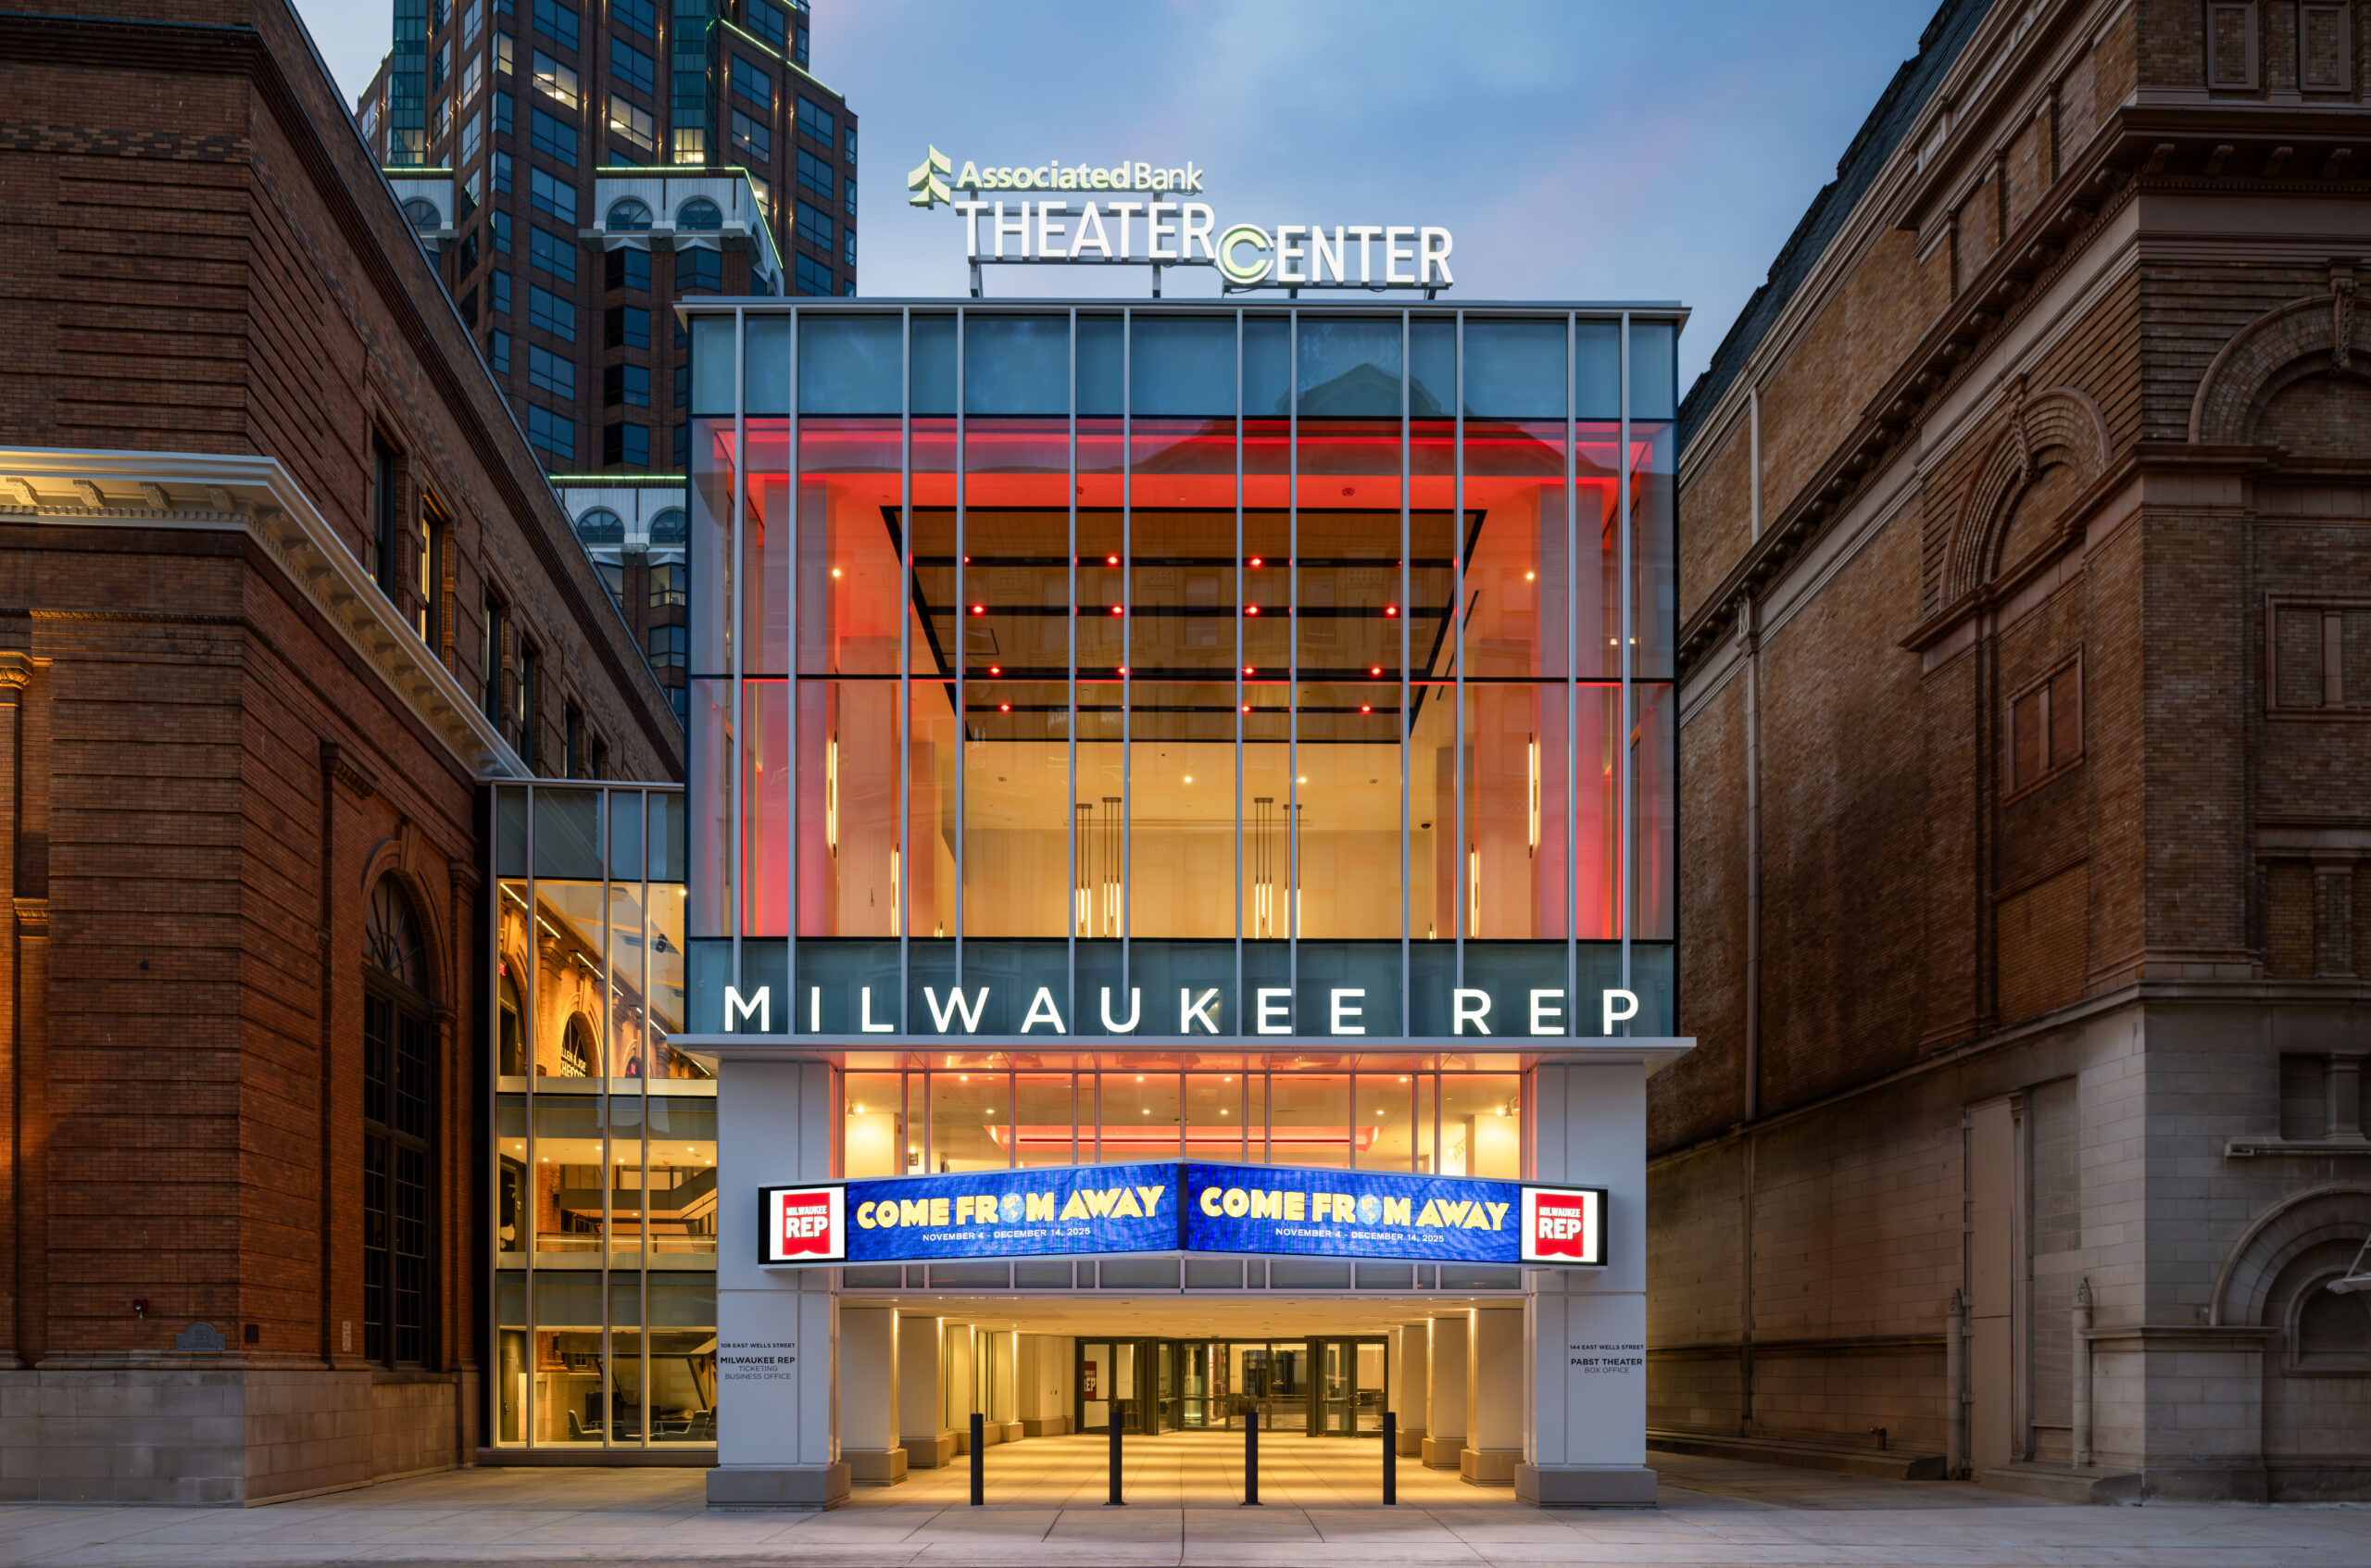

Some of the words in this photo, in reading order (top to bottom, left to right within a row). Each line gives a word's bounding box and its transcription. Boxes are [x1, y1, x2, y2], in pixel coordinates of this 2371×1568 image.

[956, 159, 1132, 190] Associated
[1134, 160, 1203, 192] Bank
[954, 200, 1215, 259] THEATER
[1215, 223, 1454, 285] CENTER
[723, 985, 1366, 1035] MILWAUKEE
[1453, 988, 1638, 1035] REP
[786, 1205, 828, 1216] MILWAUKEE
[856, 1198, 950, 1230] COME
[956, 1191, 1056, 1225] FROM
[1059, 1185, 1166, 1222] AWAY
[1198, 1186, 1307, 1222] COME
[1311, 1192, 1412, 1227] FROM
[1414, 1198, 1511, 1232] AWAY
[1538, 1206, 1581, 1218] MILWAUKEE
[785, 1216, 829, 1239] REP
[922, 1232, 975, 1242] NOVEMBER
[994, 1229, 1047, 1239] DECEMBER
[1050, 1228, 1064, 1236] 14,
[1067, 1227, 1091, 1236] 2025
[1275, 1227, 1332, 1238] NOVEMBER
[1335, 1230, 1341, 1238] 4
[1351, 1231, 1404, 1241] DECEMBER
[1422, 1235, 1445, 1243] 2025
[1538, 1217, 1582, 1240] REP
[720, 1356, 775, 1364] MILWAUKEE
[777, 1356, 796, 1364] REP
[1571, 1358, 1599, 1366] PABST
[1601, 1358, 1643, 1366] THEATER
